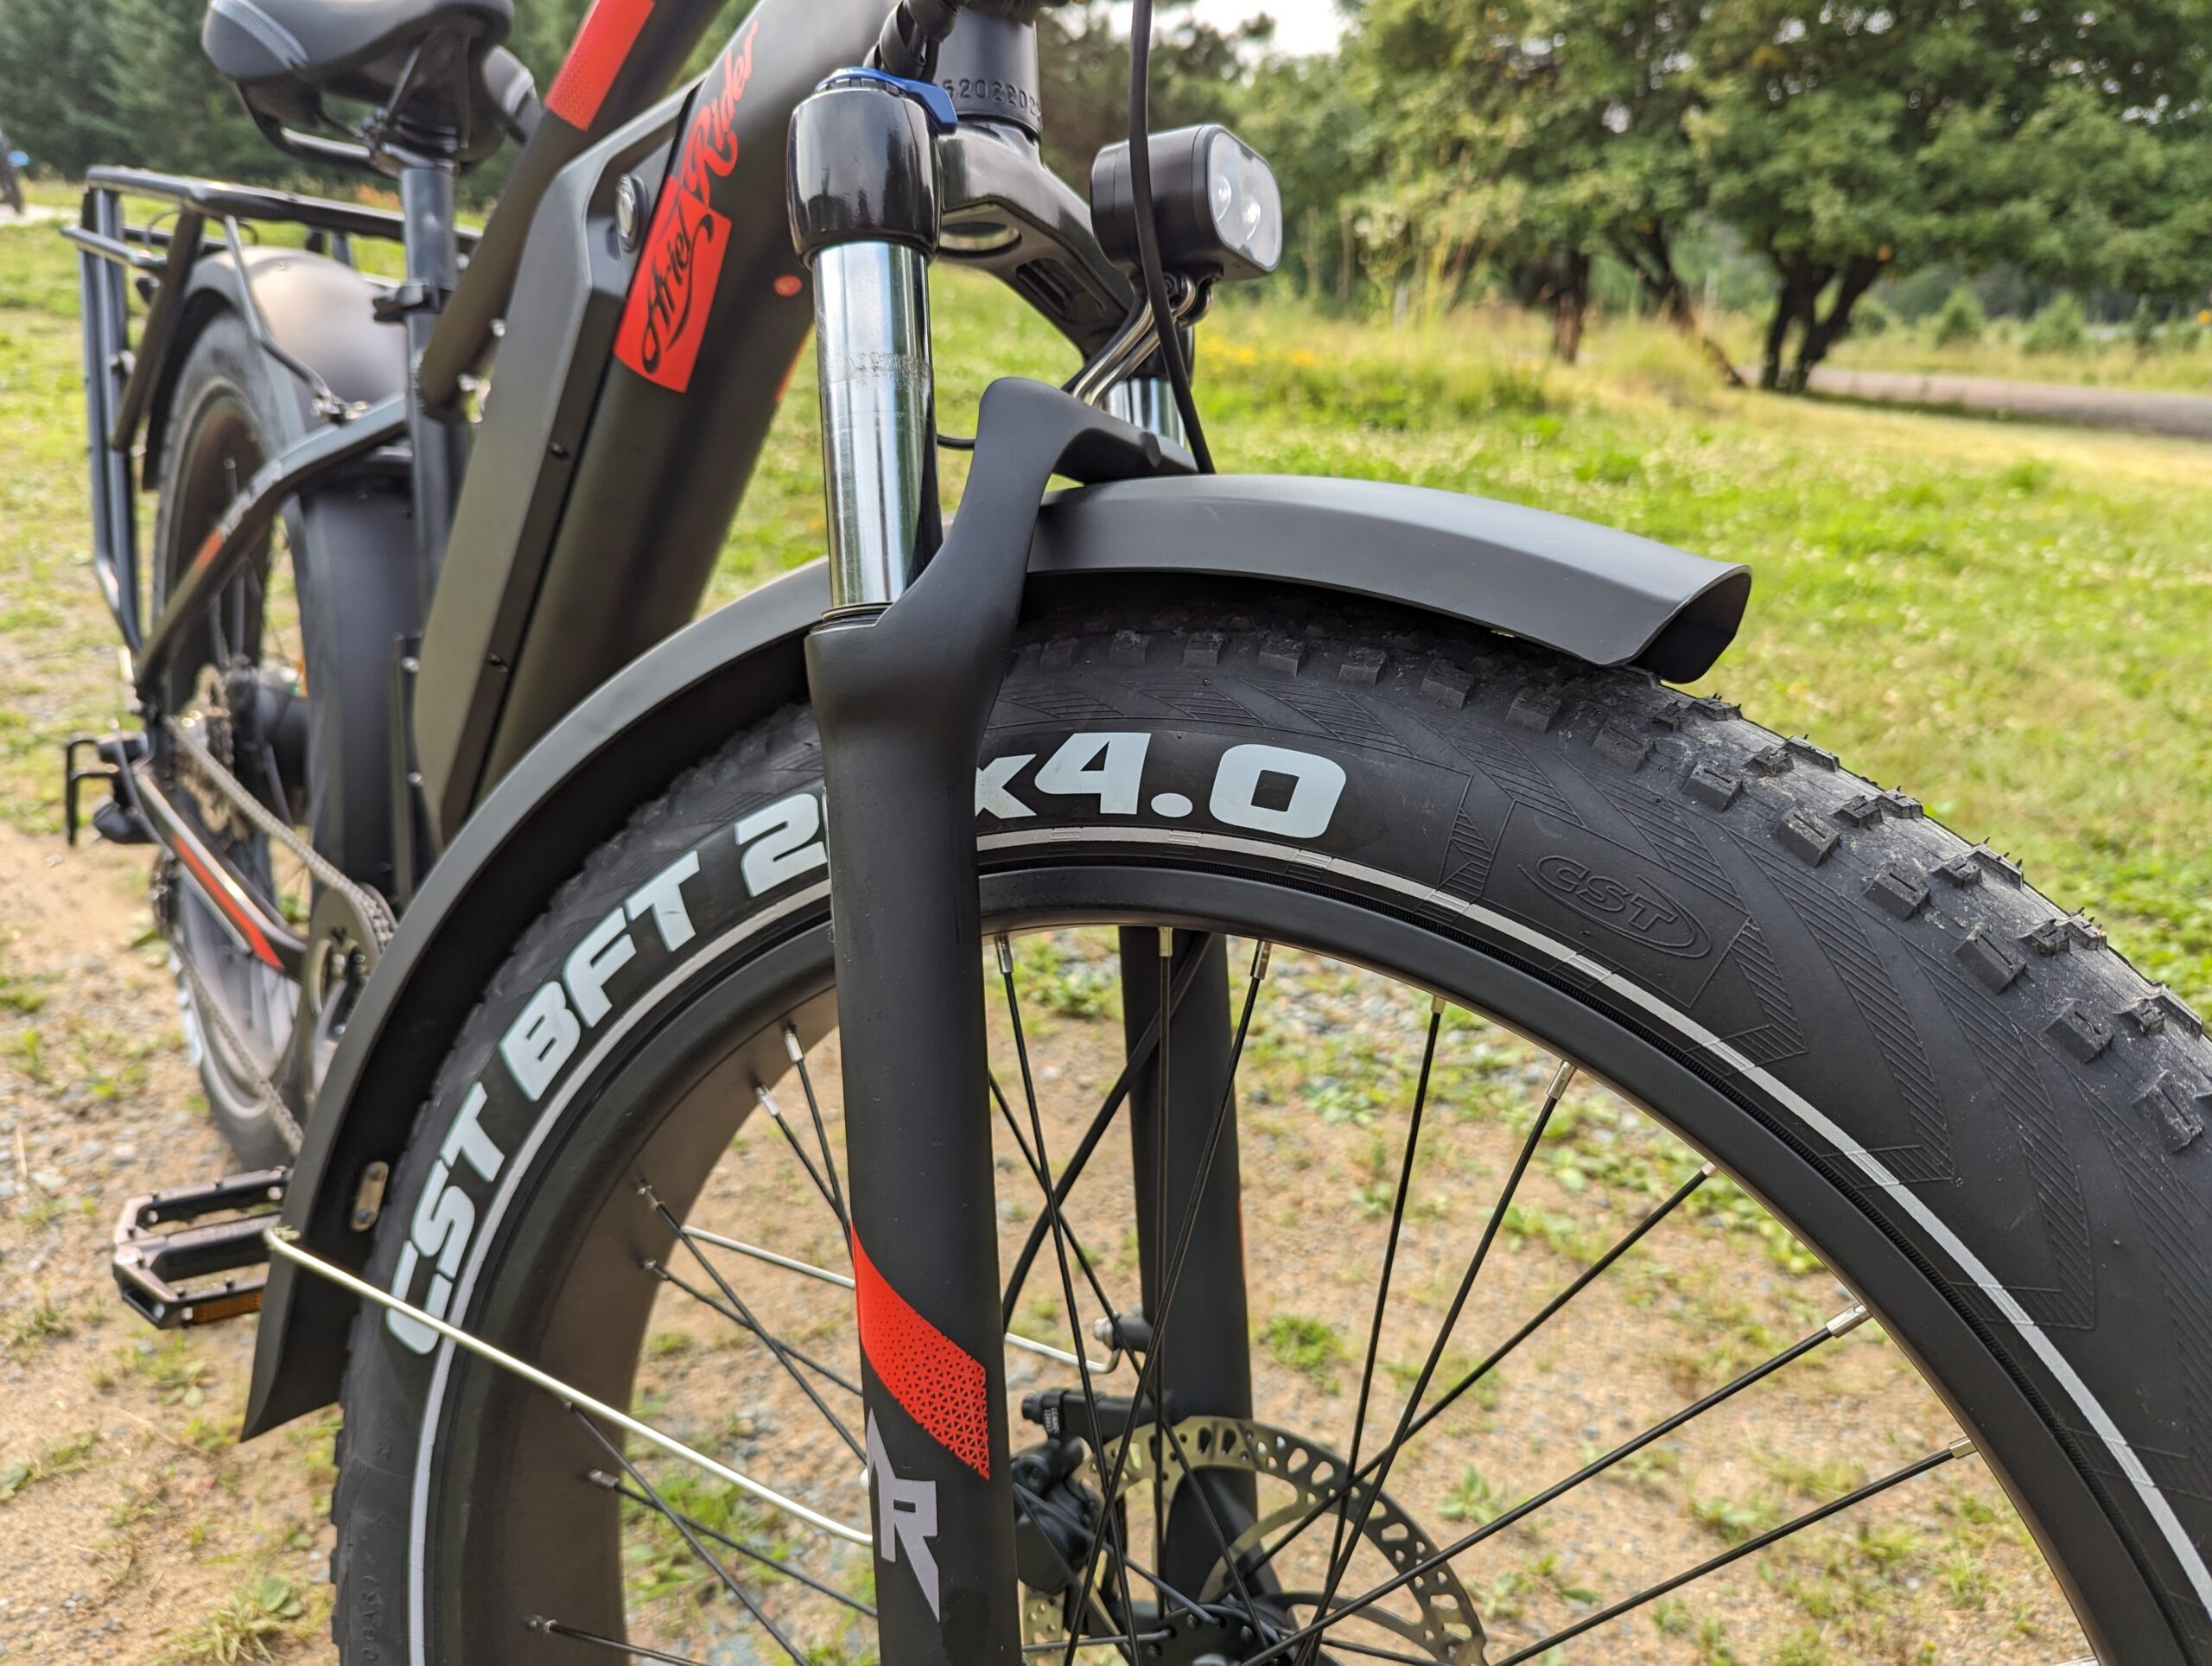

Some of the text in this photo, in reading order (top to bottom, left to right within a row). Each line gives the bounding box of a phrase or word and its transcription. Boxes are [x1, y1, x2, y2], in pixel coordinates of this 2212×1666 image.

[678, 21, 759, 208] Rider
[1536, 855, 1678, 932] CST
[385, 1082, 505, 1354] CST
[499, 850, 700, 1103] BFT
